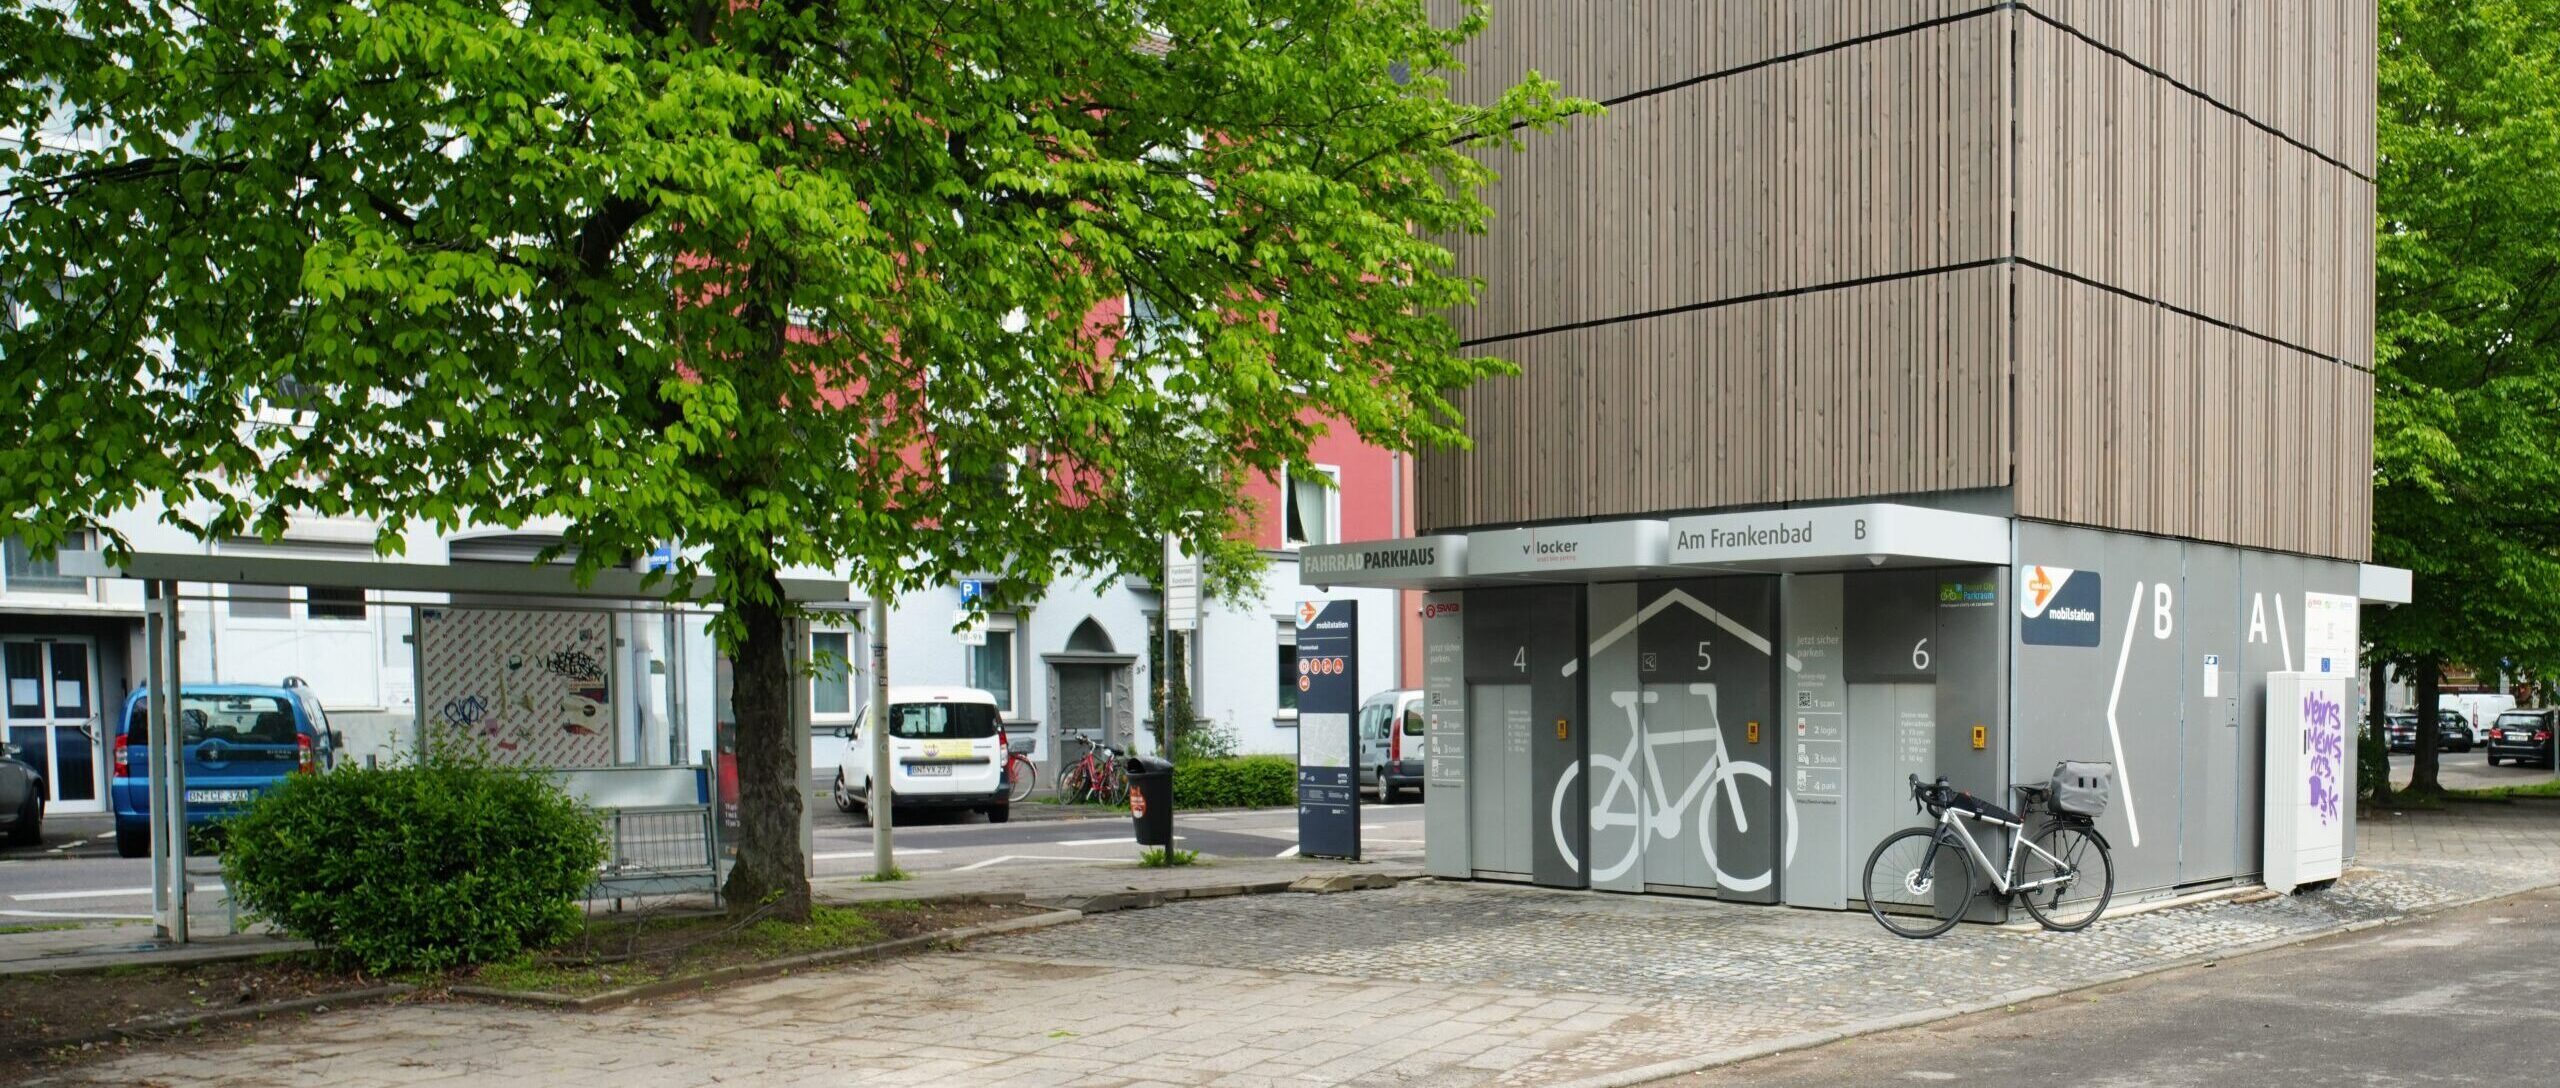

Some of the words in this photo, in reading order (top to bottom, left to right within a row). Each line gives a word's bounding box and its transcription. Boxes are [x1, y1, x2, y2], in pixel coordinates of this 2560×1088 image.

[1677, 531, 1705, 550] Am
[1711, 520, 1812, 549] Frankenbad
[1854, 519, 1866, 540] B
[1536, 540, 1578, 554] locker
[1963, 591, 1995, 601] Parkraum
[2049, 606, 2095, 622] mobilstation
[2153, 582, 2173, 640] B
[2247, 592, 2268, 644] A
[1315, 621, 1349, 630] mobilstation
[1513, 645, 1527, 673] 4
[1697, 641, 1712, 671] 5
[1912, 637, 1930, 670] 6
[1820, 725, 1837, 737] login
[1821, 781, 1837, 792] park
